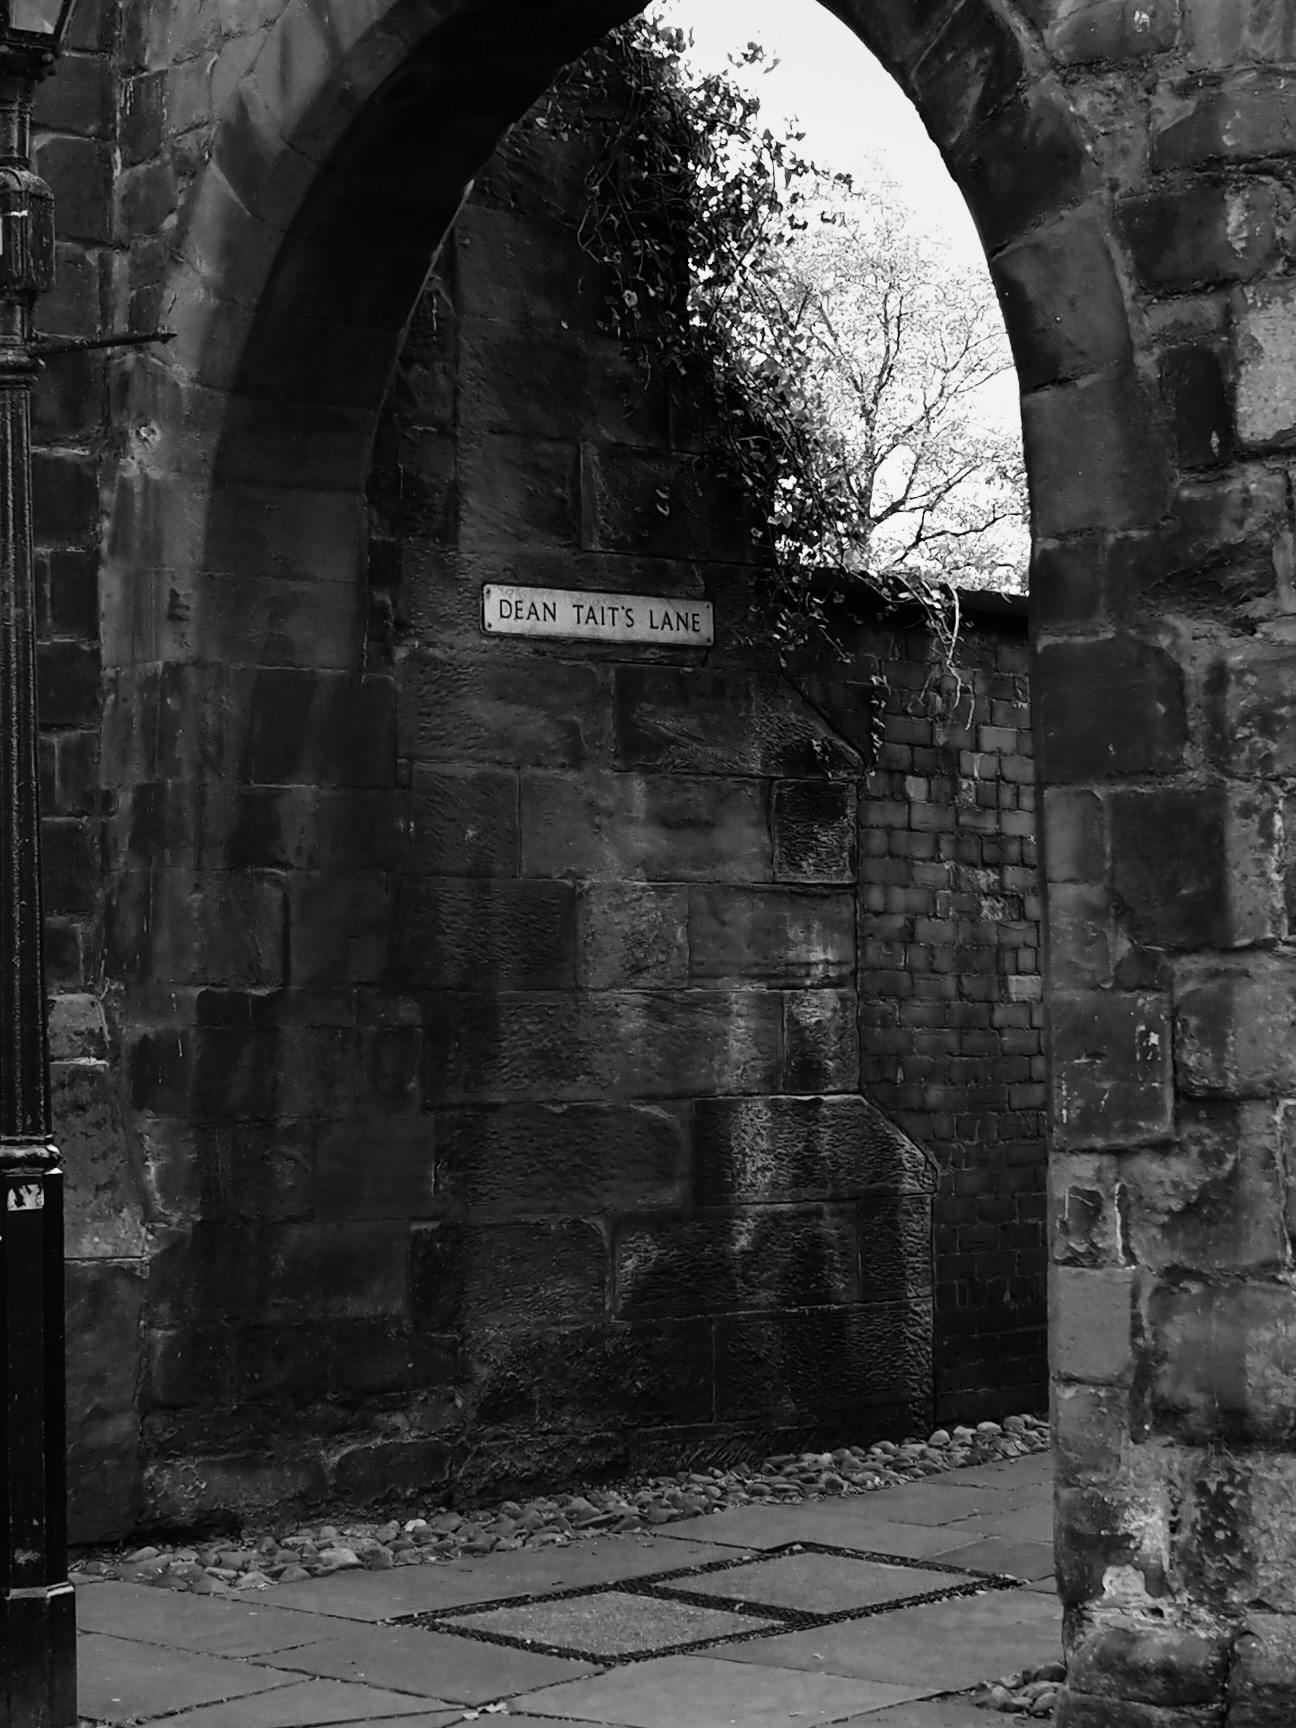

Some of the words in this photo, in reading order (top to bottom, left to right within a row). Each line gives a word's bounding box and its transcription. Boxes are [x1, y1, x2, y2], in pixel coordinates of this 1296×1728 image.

[499, 599, 557, 622] DEAN
[572, 604, 635, 628] TAIT'S
[649, 609, 701, 633] LANE
